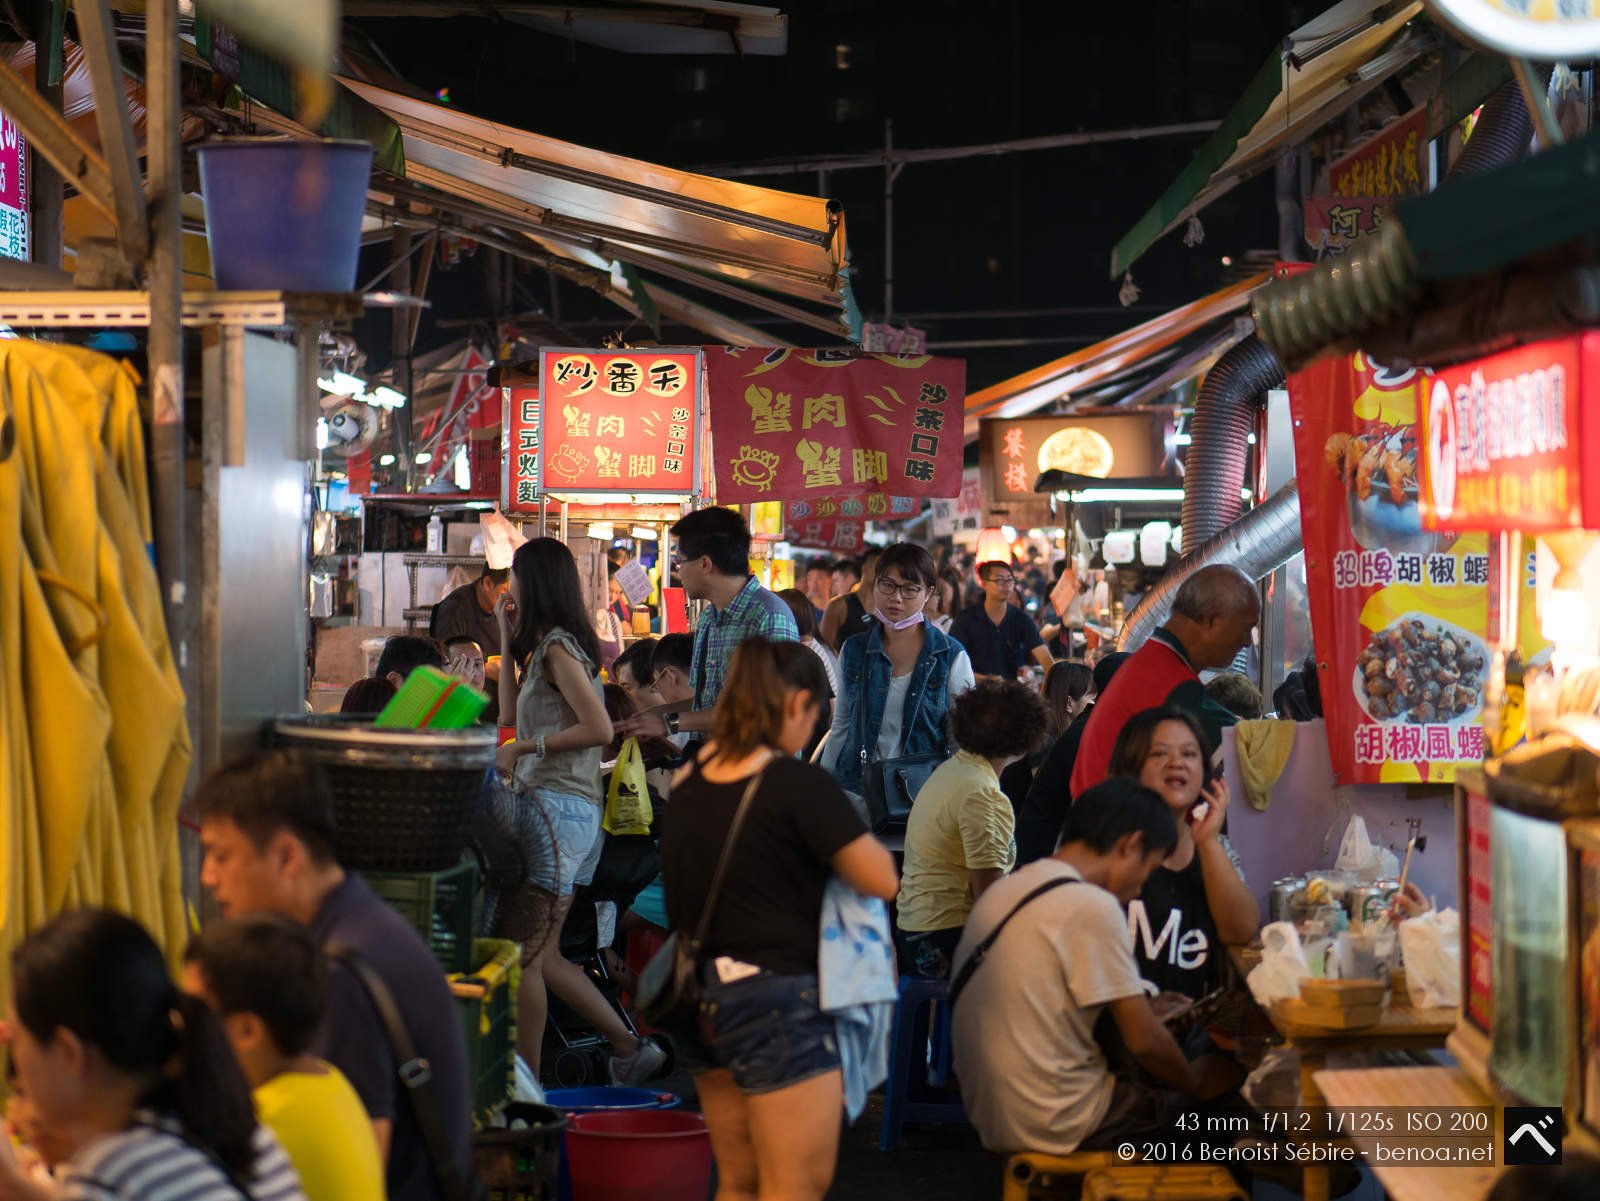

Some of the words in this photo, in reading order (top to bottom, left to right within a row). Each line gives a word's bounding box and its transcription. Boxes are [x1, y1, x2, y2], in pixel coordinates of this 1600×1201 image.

[9, 211, 20, 260] 花枝
[563, 403, 625, 438] 蟹肉
[744, 383, 847, 434] 蟹肉
[904, 382, 948, 483] 沙茶口味
[664, 406, 690, 473] 沙茶口味
[1356, 725, 1484, 761] 胡椒風螺
[1127, 900, 1208, 969] Me
